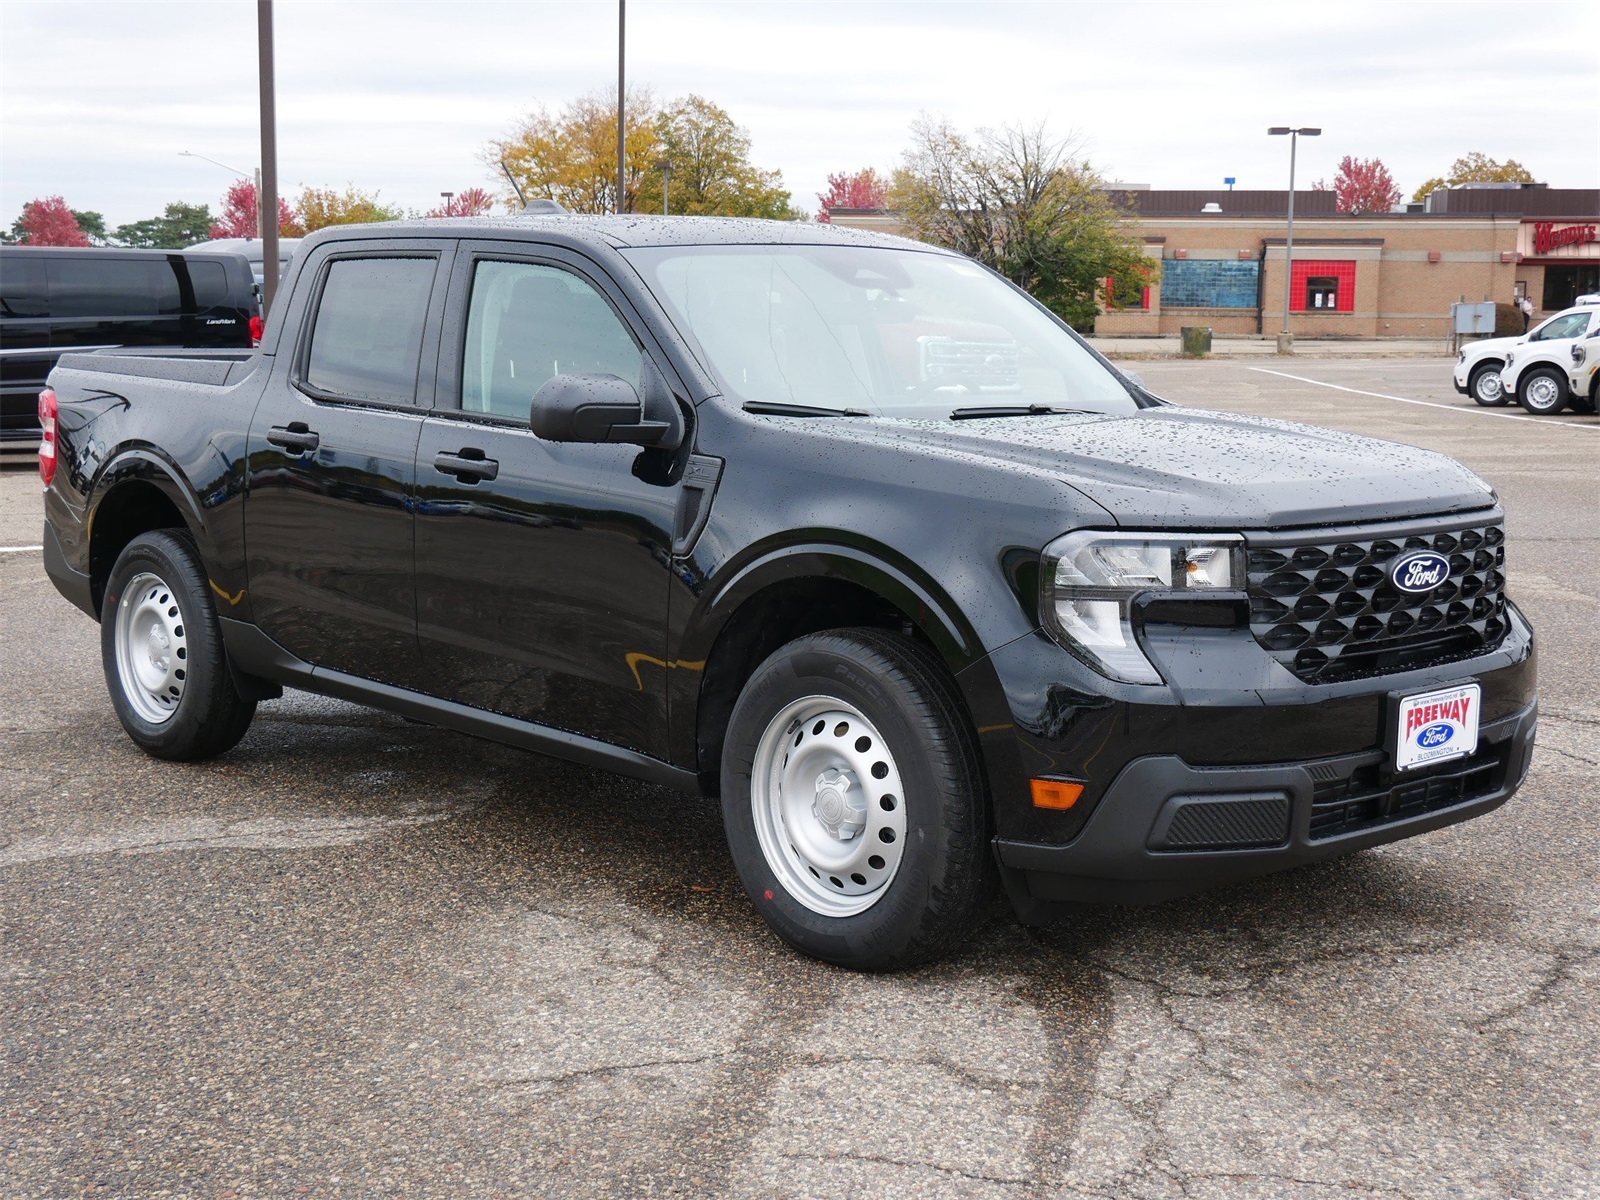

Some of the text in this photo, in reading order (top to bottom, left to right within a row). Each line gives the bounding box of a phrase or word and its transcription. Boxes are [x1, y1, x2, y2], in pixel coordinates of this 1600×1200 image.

[1404, 560, 1440, 587] Ford
[1405, 697, 1470, 743] FREEWAY
[1423, 726, 1448, 745] Ford
[1417, 747, 1453, 760] BLOOMINGTON
